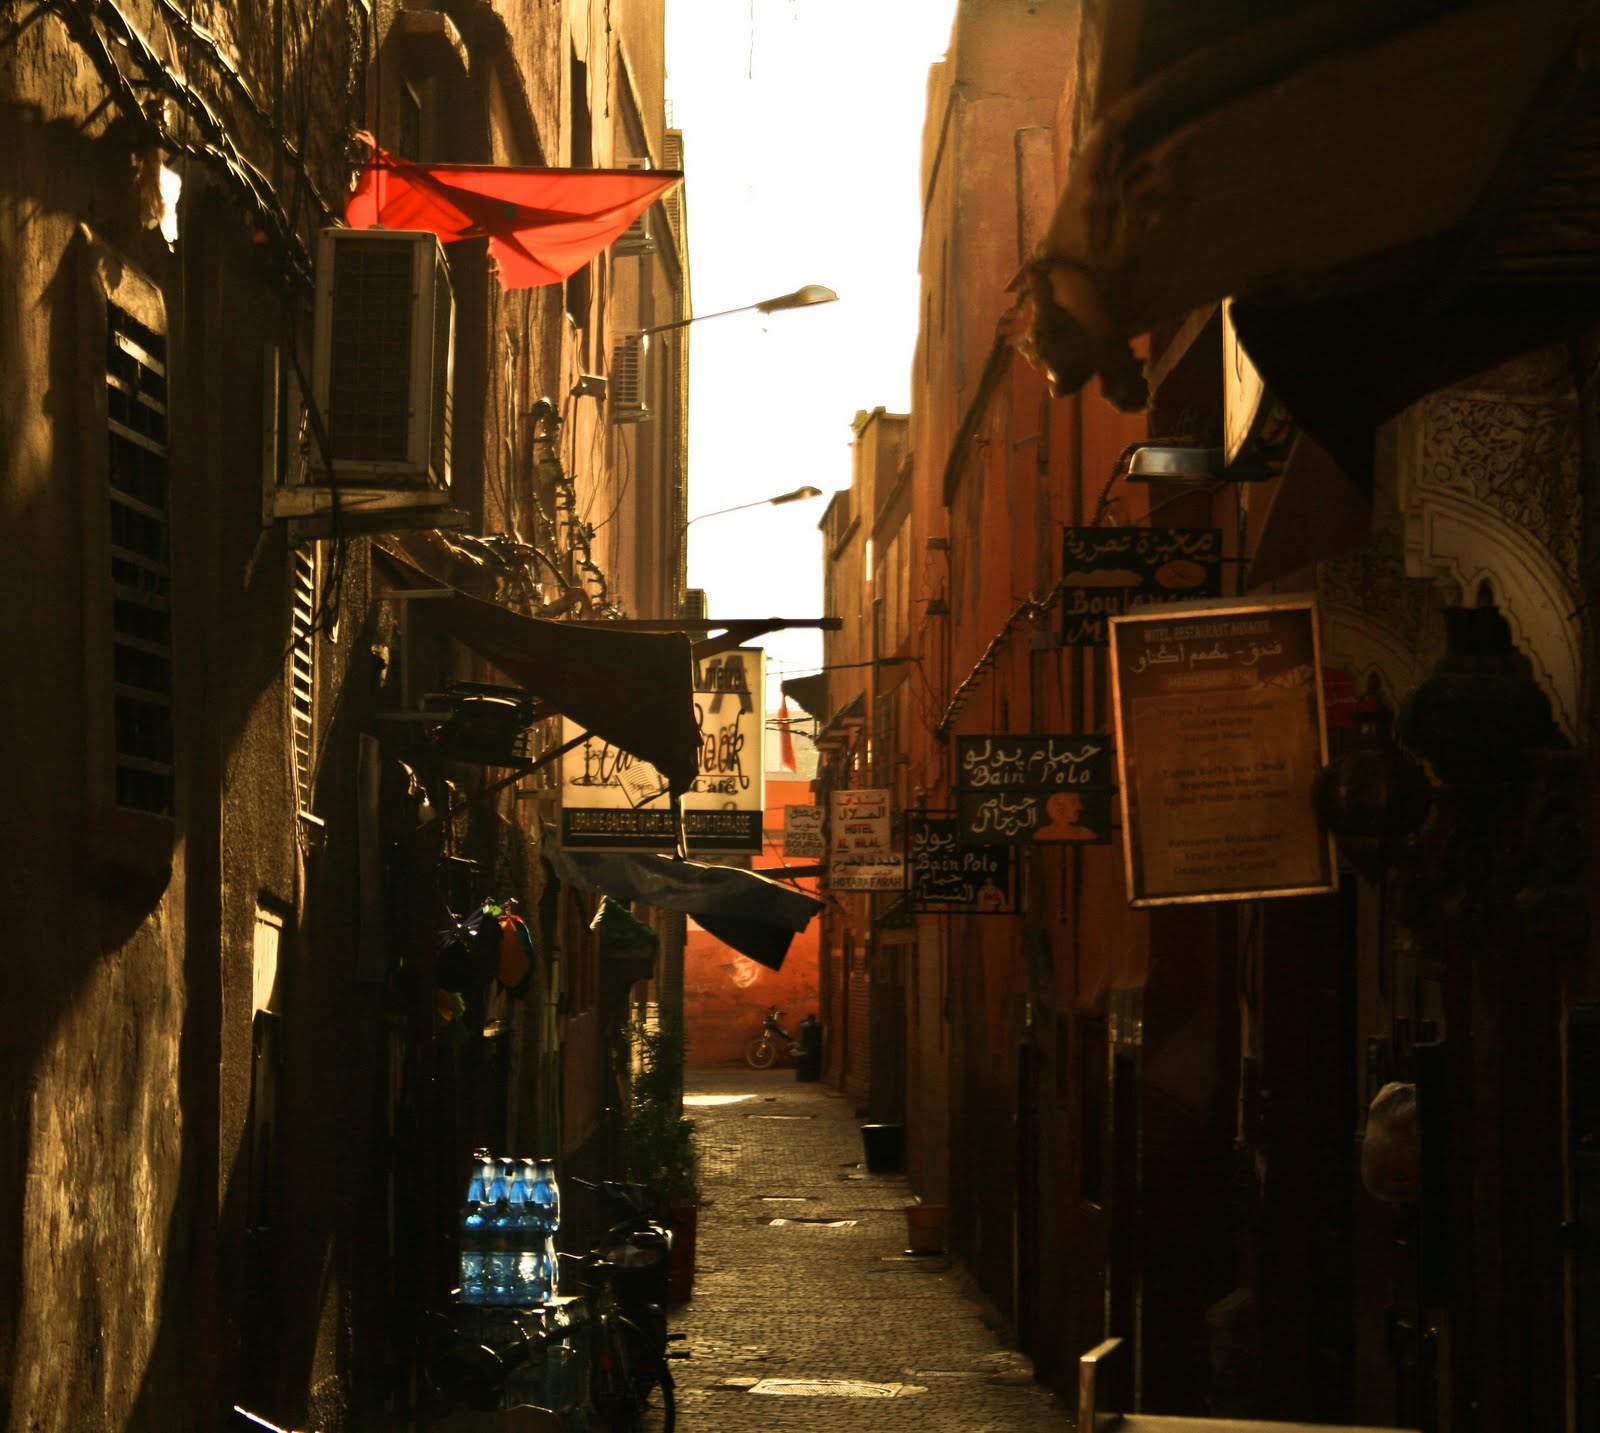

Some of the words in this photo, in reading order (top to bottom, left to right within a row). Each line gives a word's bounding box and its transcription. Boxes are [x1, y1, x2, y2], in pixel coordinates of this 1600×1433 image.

[1027, 739, 1101, 772] حمام
[971, 765, 1024, 787] Bain
[977, 792, 1036, 817] حمام
[971, 807, 1037, 836] الرجال
[787, 832, 820, 842] HOTEL
[913, 852, 960, 871] Bain
[964, 853, 998, 872] Polo
[919, 867, 962, 886] حمام
